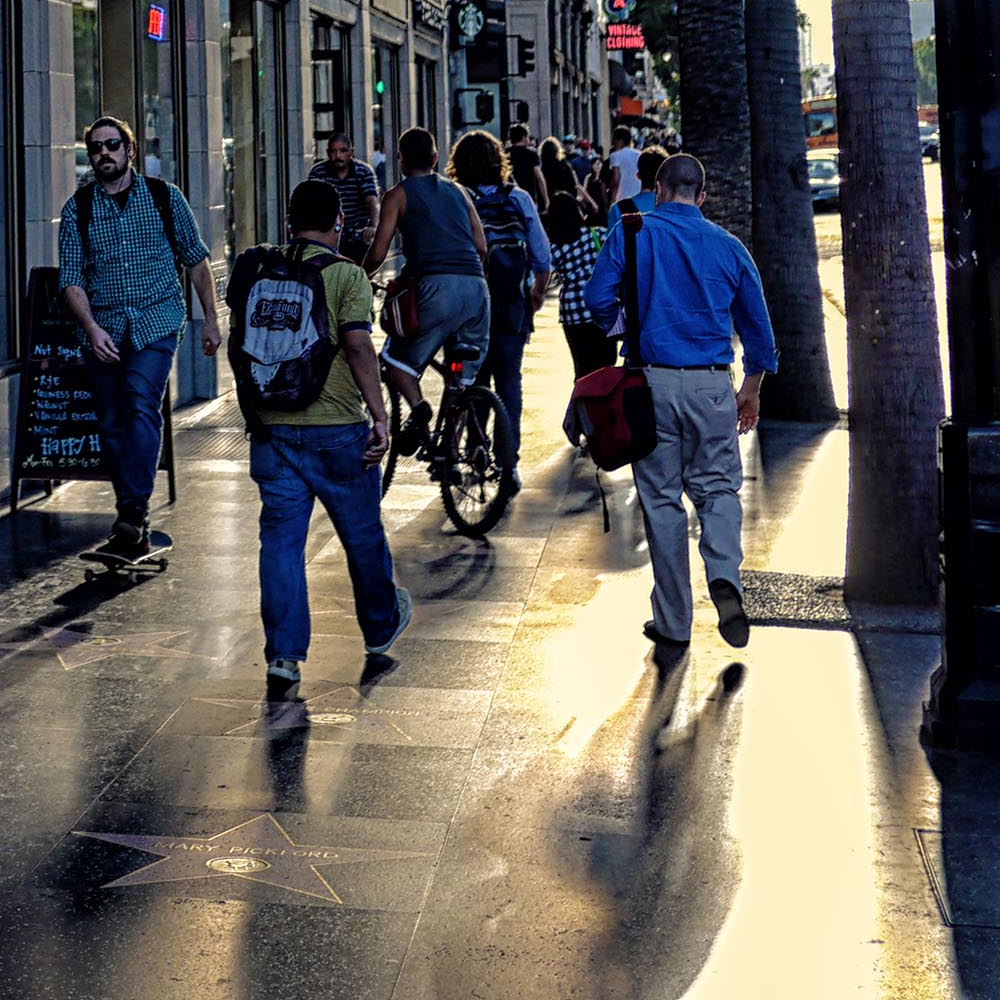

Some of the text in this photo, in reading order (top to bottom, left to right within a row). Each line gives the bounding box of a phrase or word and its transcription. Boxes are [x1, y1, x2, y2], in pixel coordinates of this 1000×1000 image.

[607, 23, 642, 36] VINTAGE
[606, 36, 645, 49] CLOTHING
[153, 841, 340, 859] MARY PICKFORD
